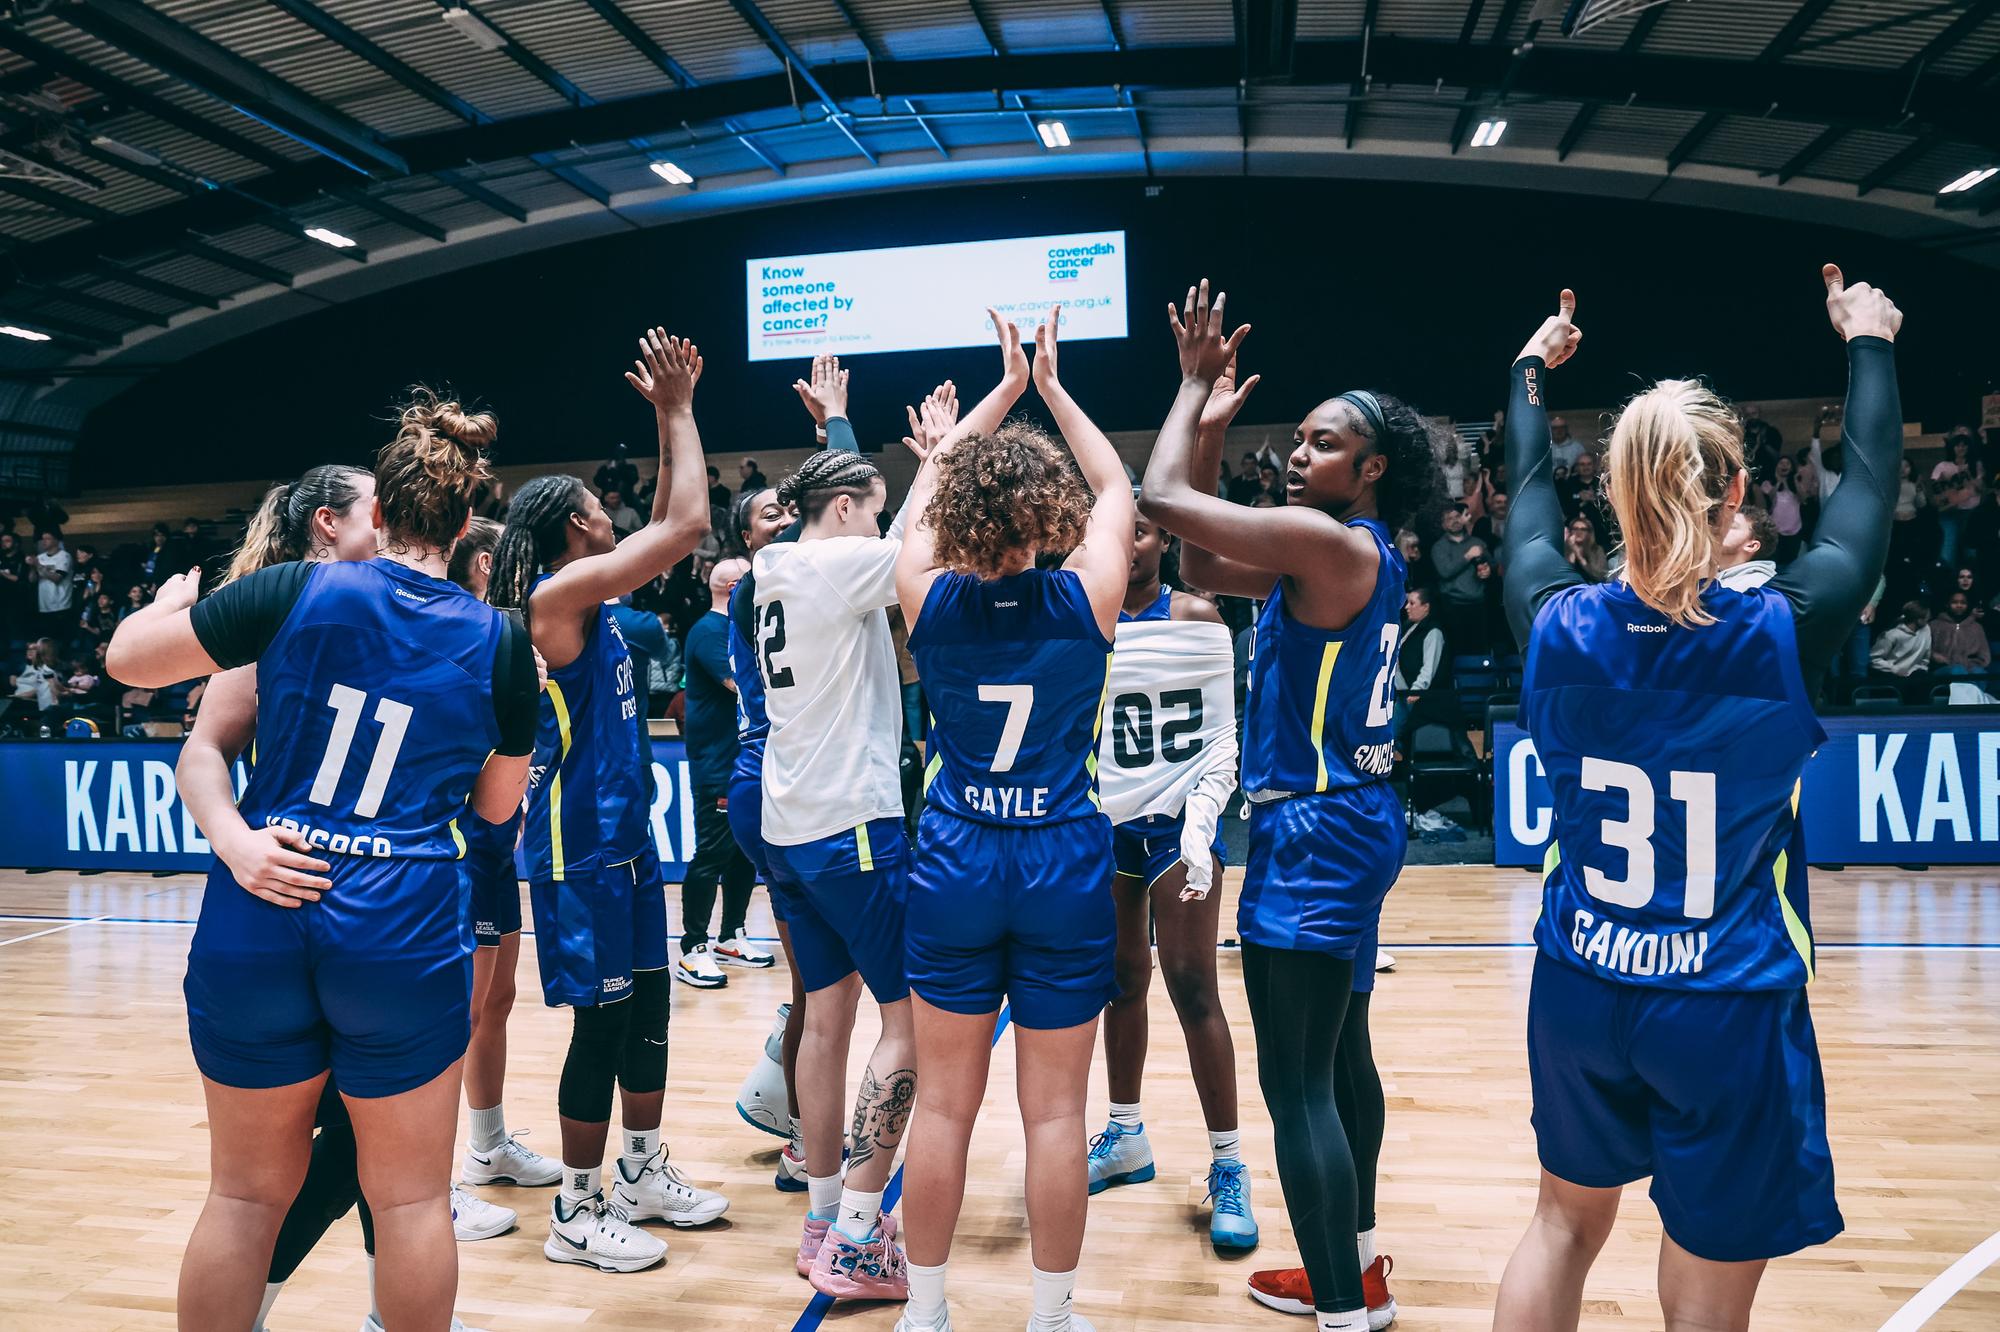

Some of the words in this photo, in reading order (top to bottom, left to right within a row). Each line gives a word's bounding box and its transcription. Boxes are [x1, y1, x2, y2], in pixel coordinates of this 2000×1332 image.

[1048, 243, 1115, 258] cavendish
[1048, 257, 1094, 269] cancer
[762, 266, 805, 280] Know
[1048, 269, 1079, 279] care
[762, 281, 836, 297] someone
[762, 296, 829, 314] affected
[833, 295, 854, 311] by
[762, 313, 828, 331] cancer?
[1525, 367, 1540, 406] SKINS
[395, 588, 427, 603] Reebok
[995, 600, 1018, 608] Reebok
[1627, 623, 1668, 633] Reebok
[977, 684, 1034, 773] 7
[308, 683, 414, 819] 11
[964, 785, 1049, 819] GAYLE
[1581, 756, 1717, 919] 31
[1571, 908, 1709, 976] GANDINI
